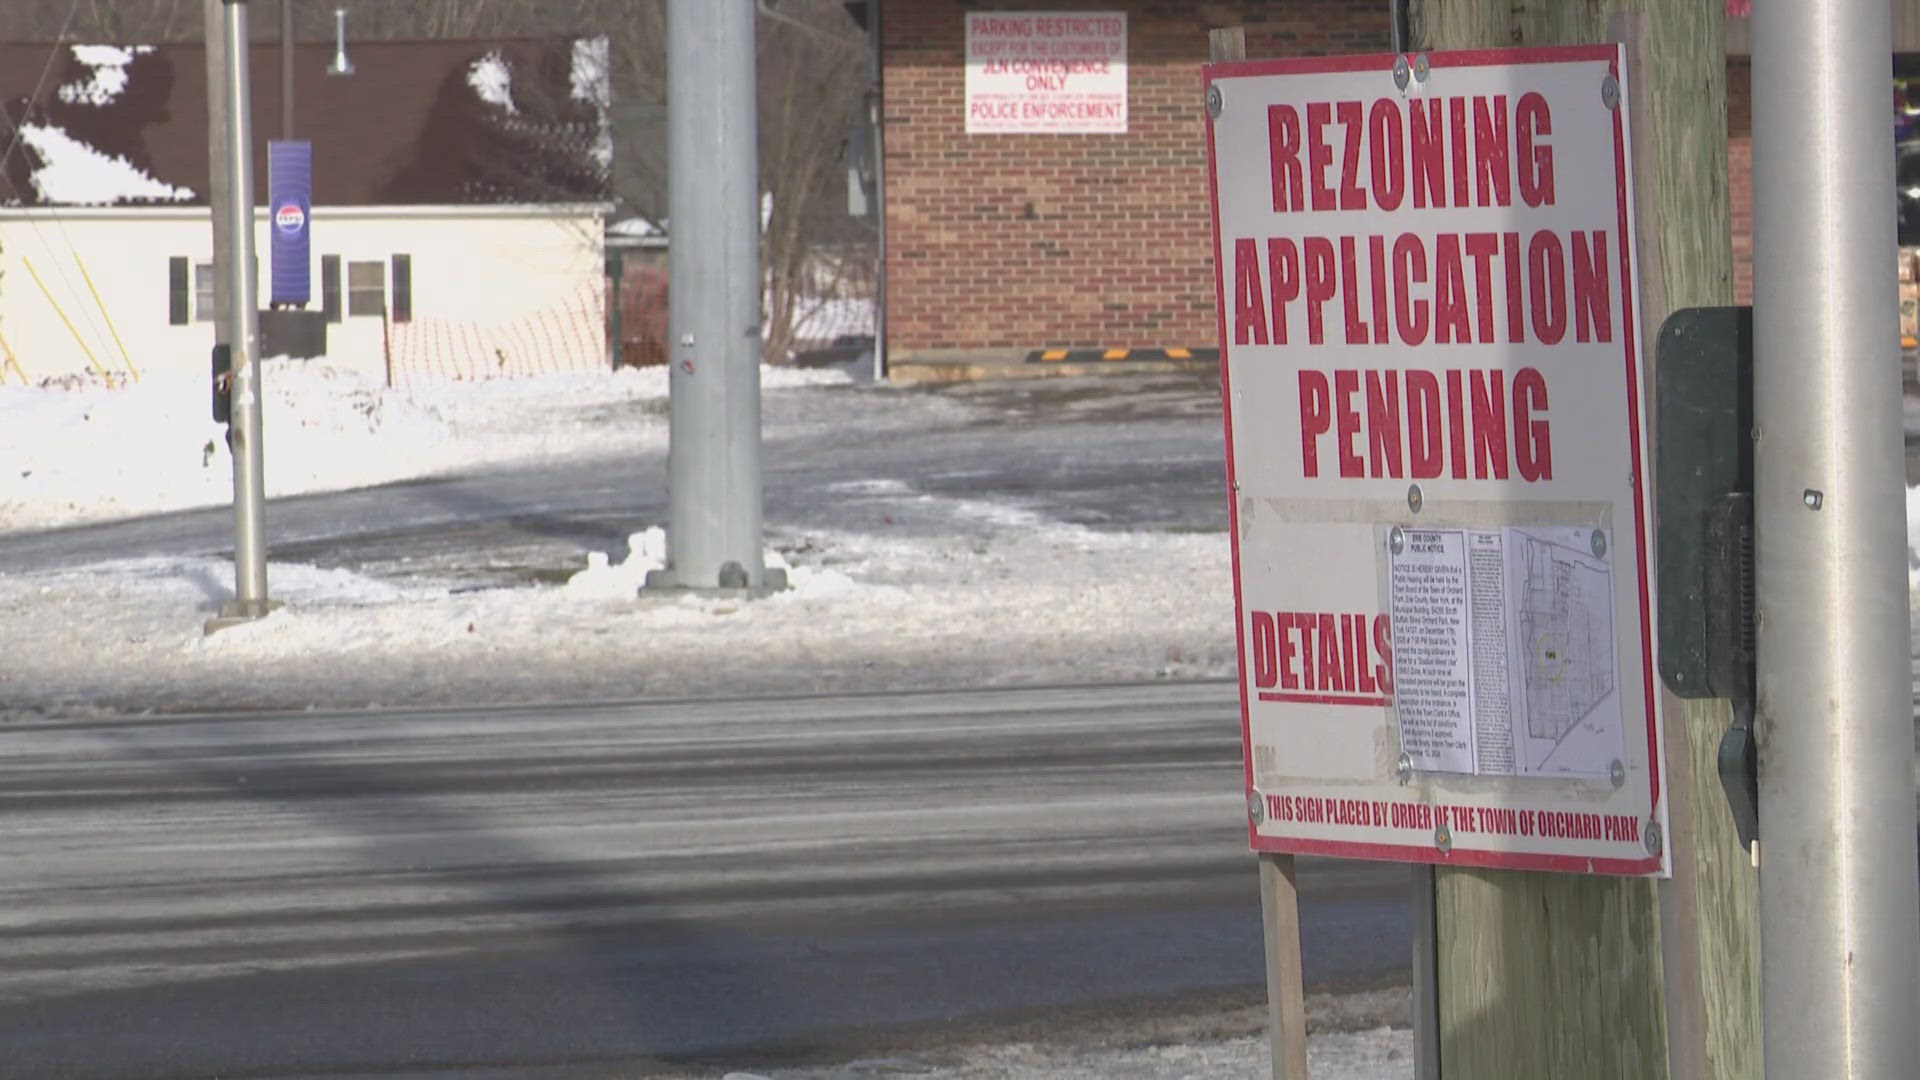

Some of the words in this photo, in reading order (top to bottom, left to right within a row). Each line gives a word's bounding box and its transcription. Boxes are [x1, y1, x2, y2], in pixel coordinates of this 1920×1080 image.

[971, 17, 1033, 37] PARKING
[1036, 17, 1121, 37] RESTRICTED
[1012, 58, 1111, 74] CONVENIENCE
[1025, 75, 1067, 91] ONLY
[971, 102, 1018, 119] POLICE
[1023, 102, 1121, 119] ENFORCEMENT
[1267, 92, 1555, 212] REZONING
[1234, 229, 1612, 346] APPLICATION
[1298, 367, 1553, 482] PENDING
[1251, 611, 1394, 694] DETAILS
[1266, 794, 1294, 822] THIS
[1295, 796, 1324, 824] SIGN
[1326, 797, 1371, 827] PLACED
[1373, 800, 1389, 828] BY
[1391, 801, 1432, 830] ORDER
[1434, 804, 1449, 831] OF
[1451, 806, 1476, 833] THE
[1477, 807, 1517, 835] TOWN
[1519, 809, 1535, 836] OF
[1538, 811, 1602, 840] ORCHARD
[1603, 814, 1640, 842] PARK
